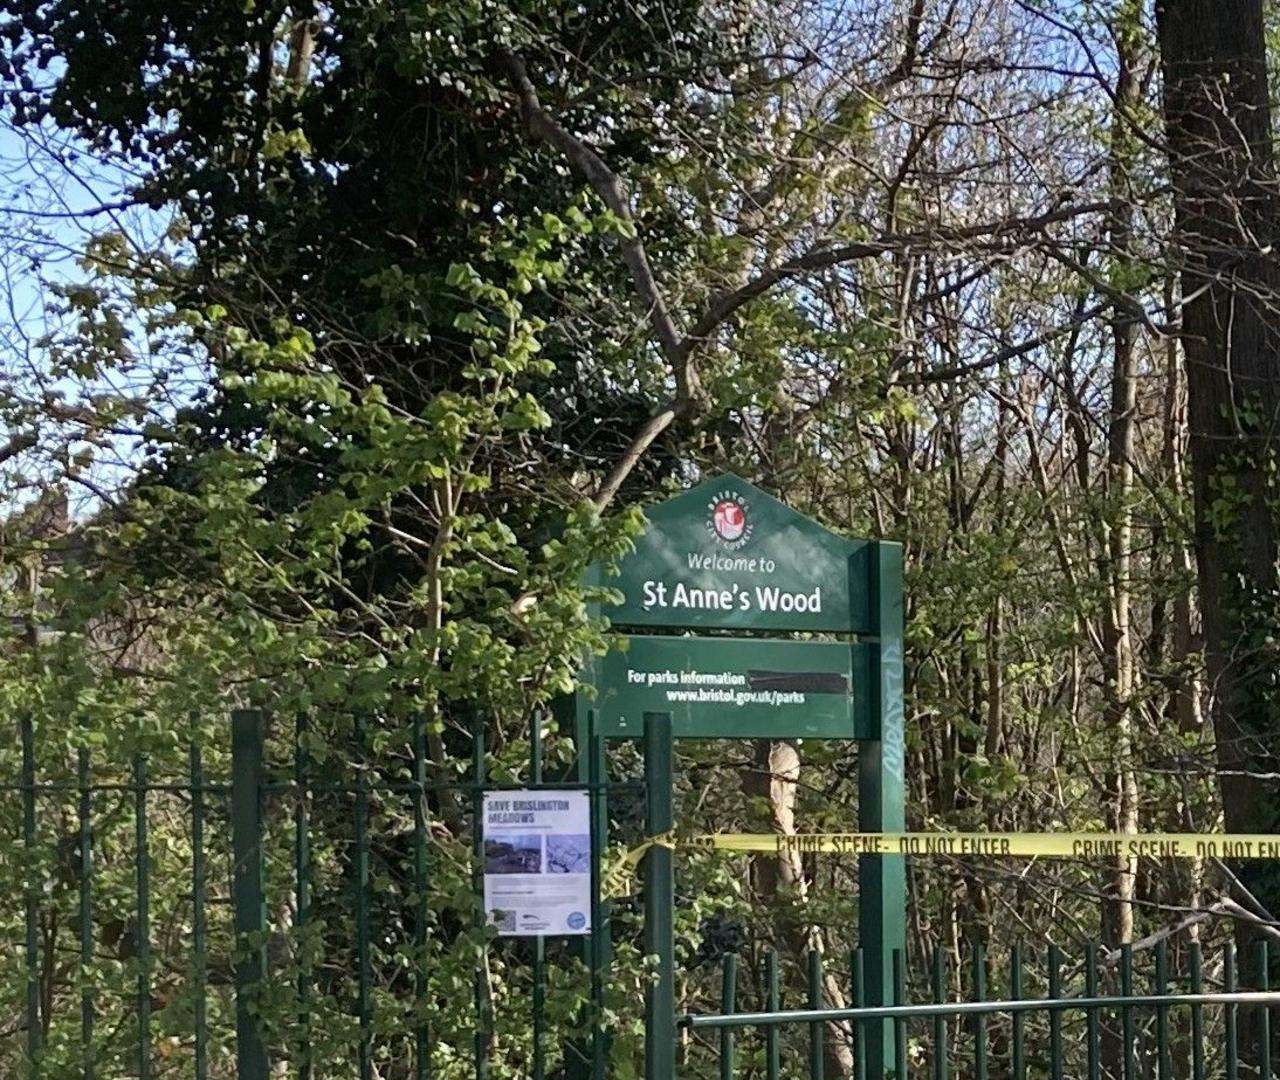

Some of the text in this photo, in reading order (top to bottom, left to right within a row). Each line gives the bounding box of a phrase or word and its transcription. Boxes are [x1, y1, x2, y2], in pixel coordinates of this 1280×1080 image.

[688, 552, 776, 574] Welcome to
[643, 580, 822, 613] St Anne's Wood
[628, 669, 746, 687] For parks information
[666, 688, 806, 706] www.bristol.gov.uk/parks
[487, 800, 511, 812] SAVE
[776, 835, 825, 852] CRIME
[899, 837, 919, 855] DO
[926, 837, 955, 855] NOT
[960, 838, 1010, 856] ENTER
[1072, 839, 1122, 857] CRIME
[1196, 841, 1217, 857] DO
[1223, 841, 1253, 858] NOT
